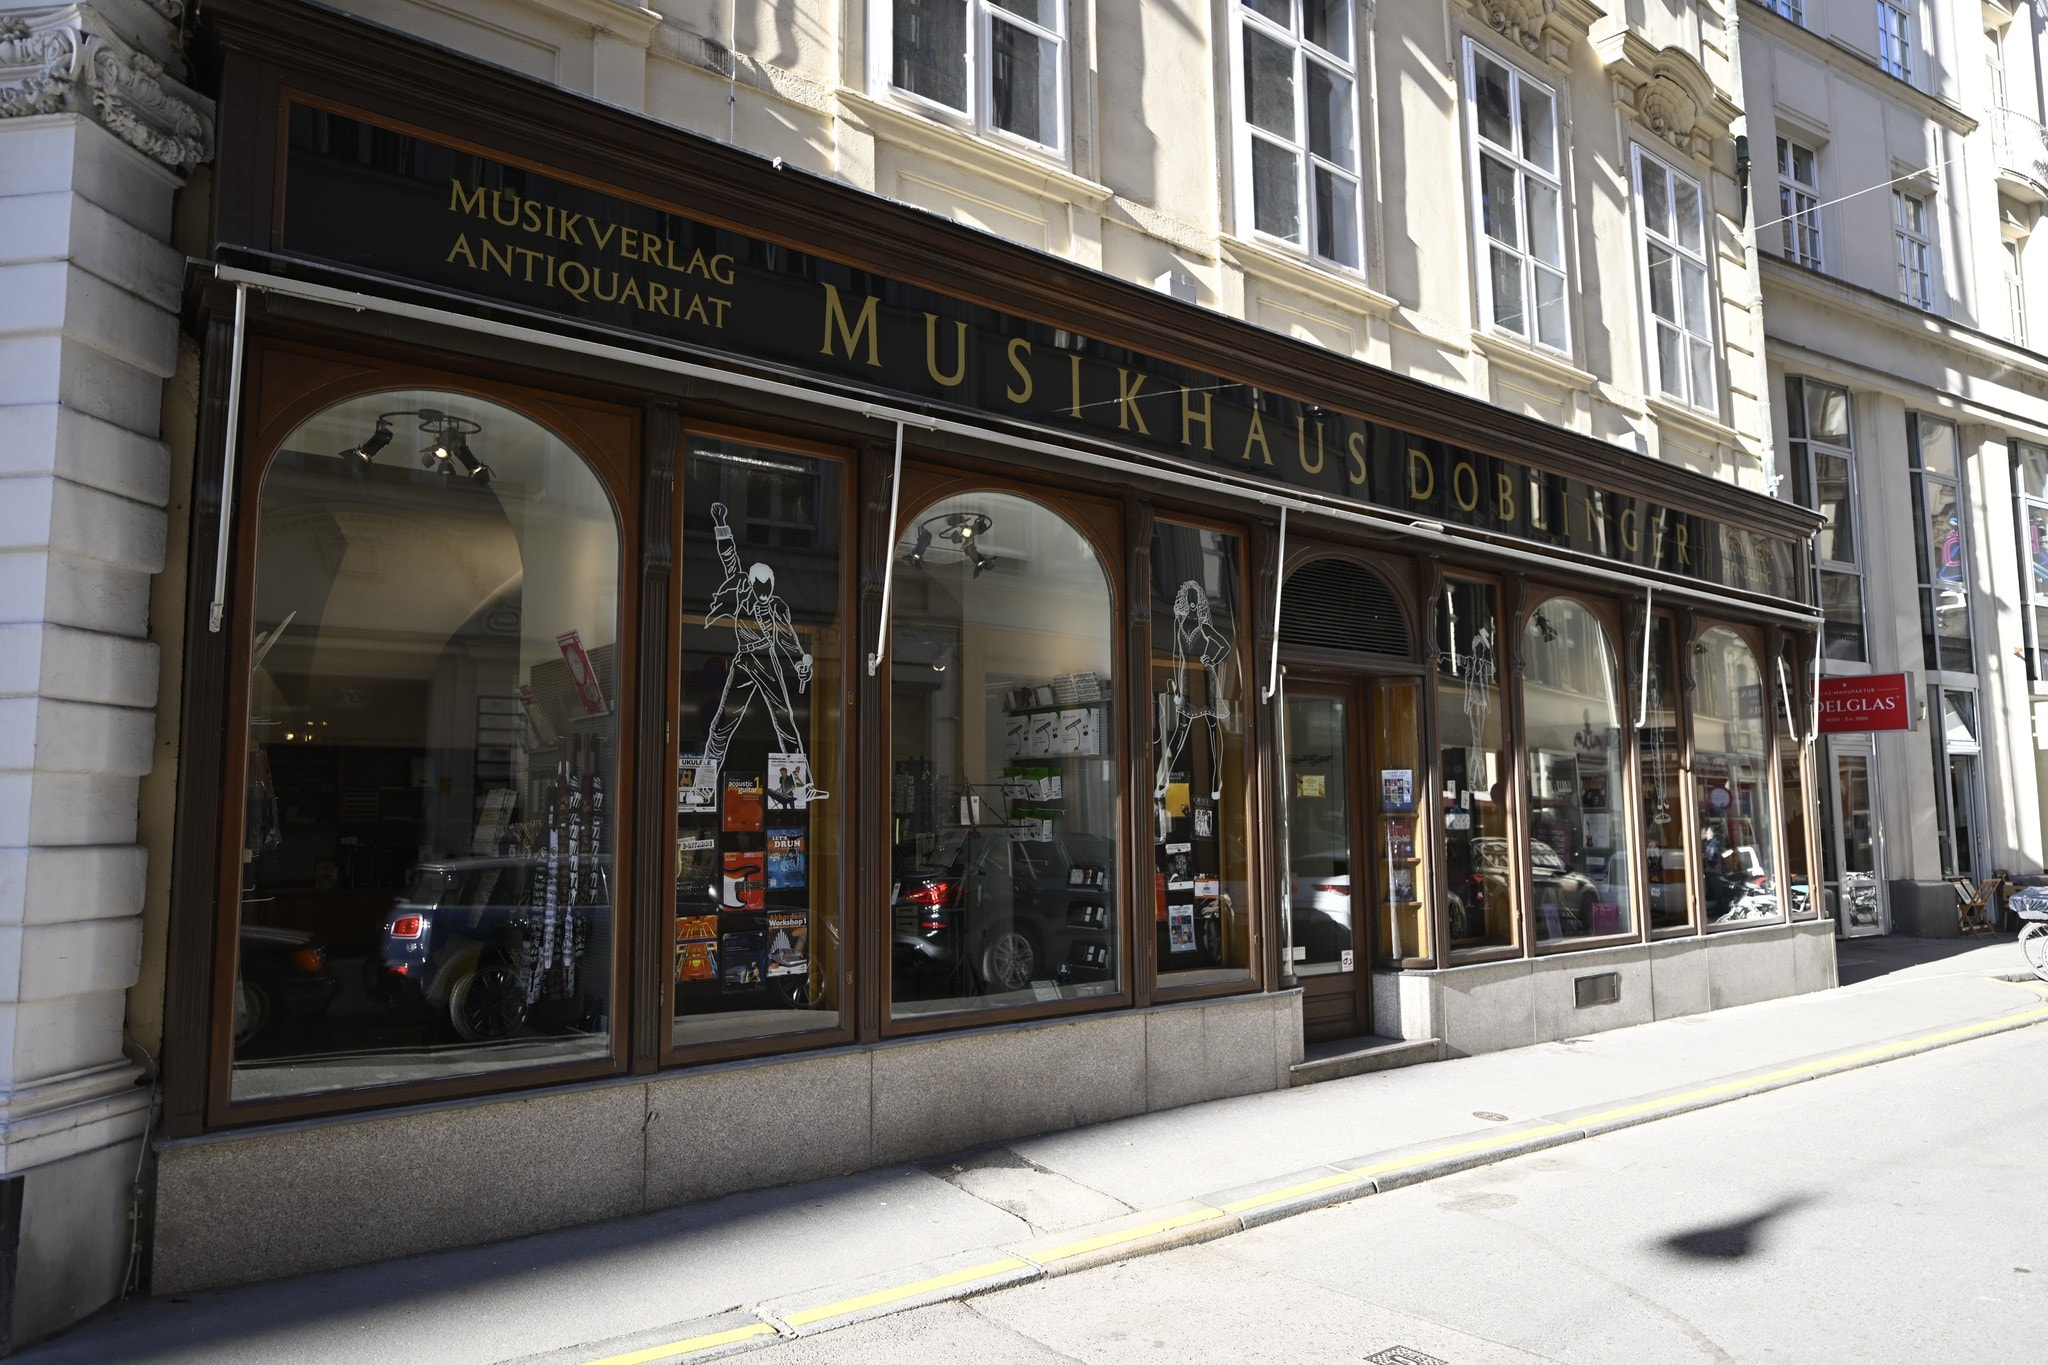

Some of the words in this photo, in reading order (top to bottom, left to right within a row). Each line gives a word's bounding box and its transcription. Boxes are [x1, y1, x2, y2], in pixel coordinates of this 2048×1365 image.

[449, 178, 735, 286] MUSIKVERLAG
[445, 232, 732, 330] ANTIQUARIAT
[818, 281, 1368, 487] MUSIKHAUS
[1407, 448, 1691, 566] DOBLINGER
[1833, 687, 1875, 696] MANUFAKTUR
[728, 780, 753, 788] acoustic
[738, 787, 758, 795] guitar
[774, 840, 801, 848] DRUM
[768, 919, 803, 927] Workshop
